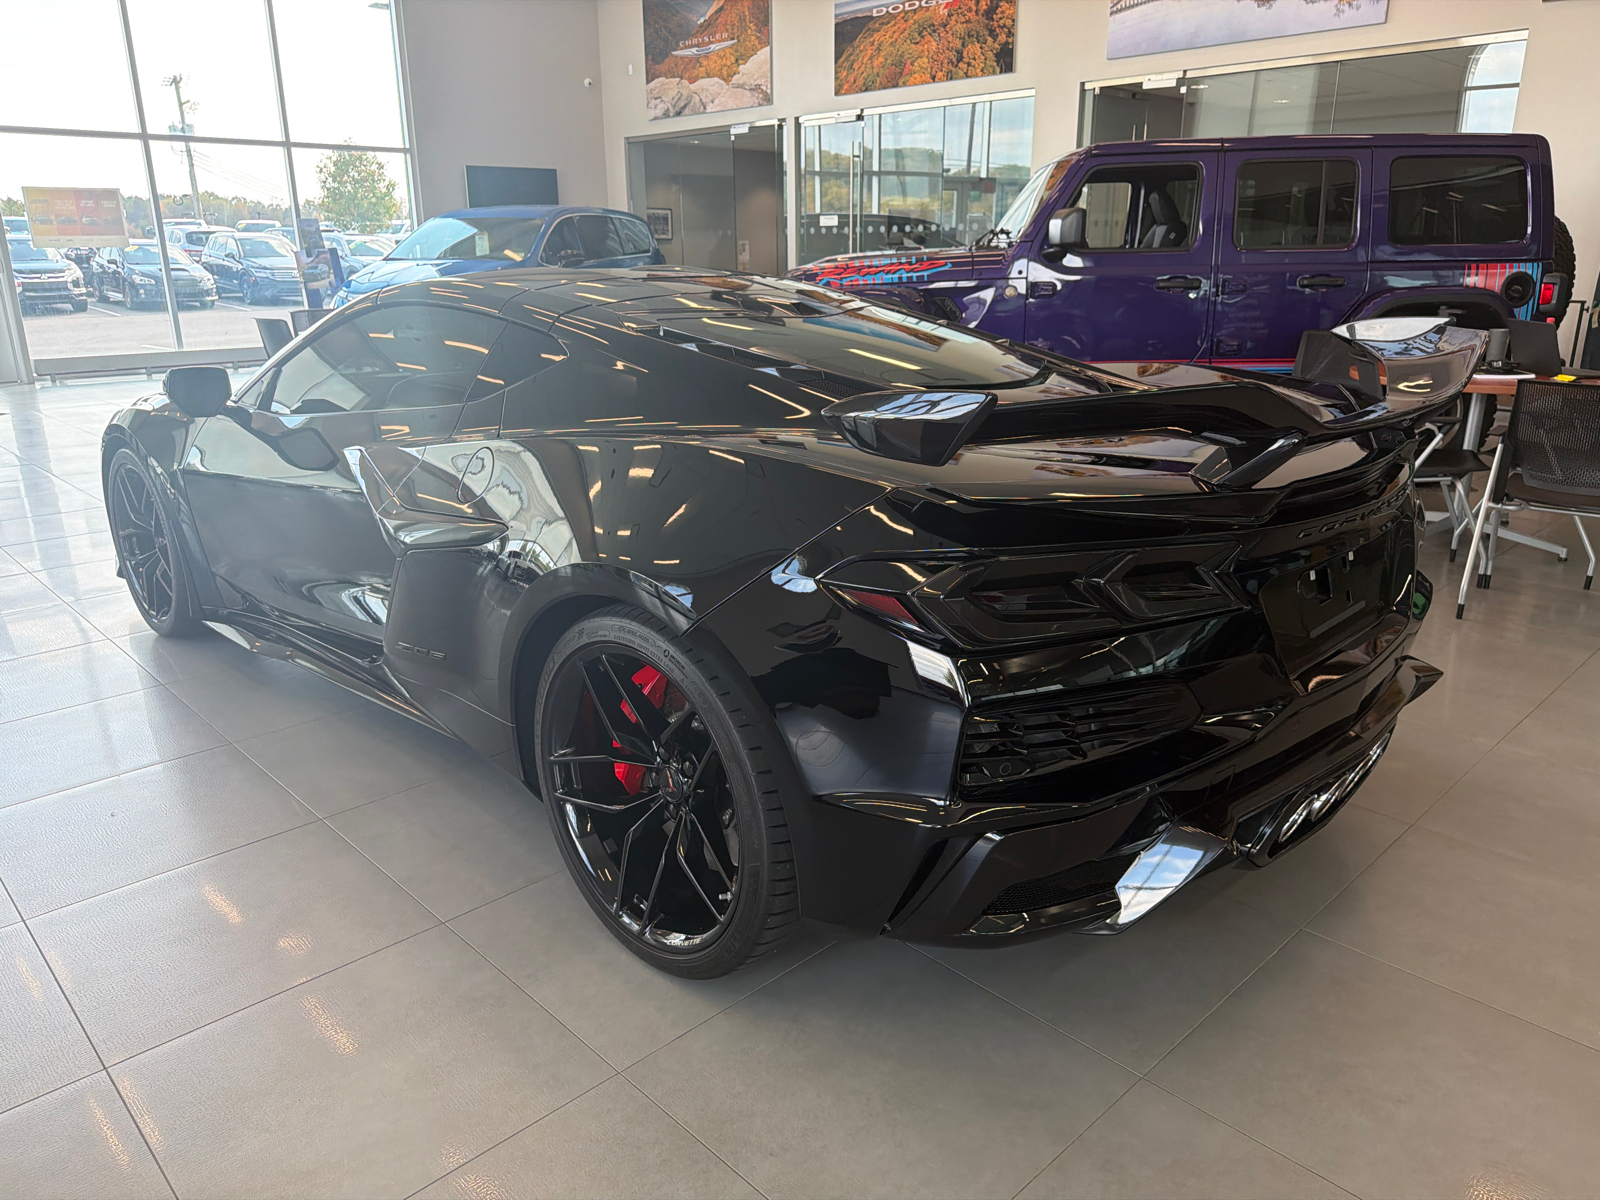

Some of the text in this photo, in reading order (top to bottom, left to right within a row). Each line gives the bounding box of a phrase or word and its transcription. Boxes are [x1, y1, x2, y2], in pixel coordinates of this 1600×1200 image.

[872, 0, 953, 17] DODG
[679, 32, 728, 47] CHRYSLER
[815, 260, 948, 283] REWIND
[395, 641, 446, 660] Z06
